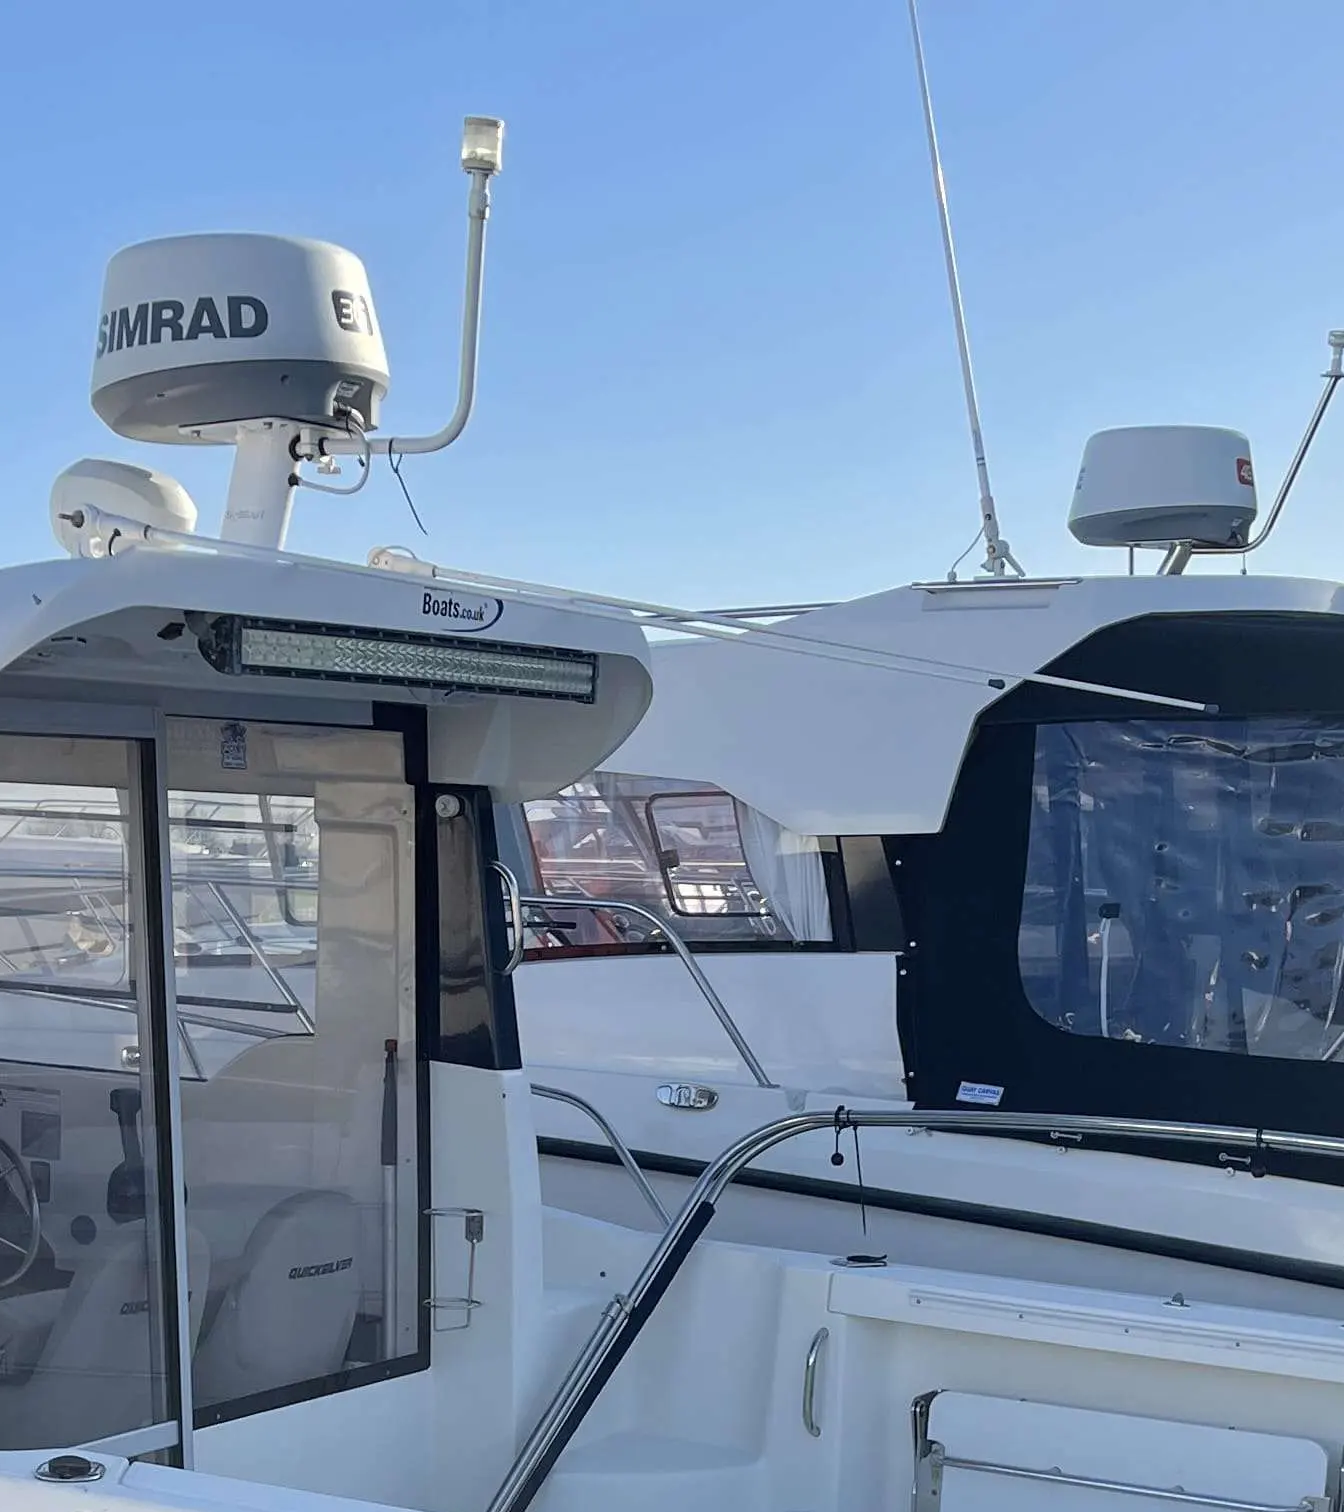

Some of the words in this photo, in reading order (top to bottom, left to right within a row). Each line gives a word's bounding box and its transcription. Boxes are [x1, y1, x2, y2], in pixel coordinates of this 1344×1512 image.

[96, 296, 269, 358] SIMRAD
[422, 592, 485, 622] Boats.co.uk
[288, 1257, 354, 1279] QUICKSILVER
